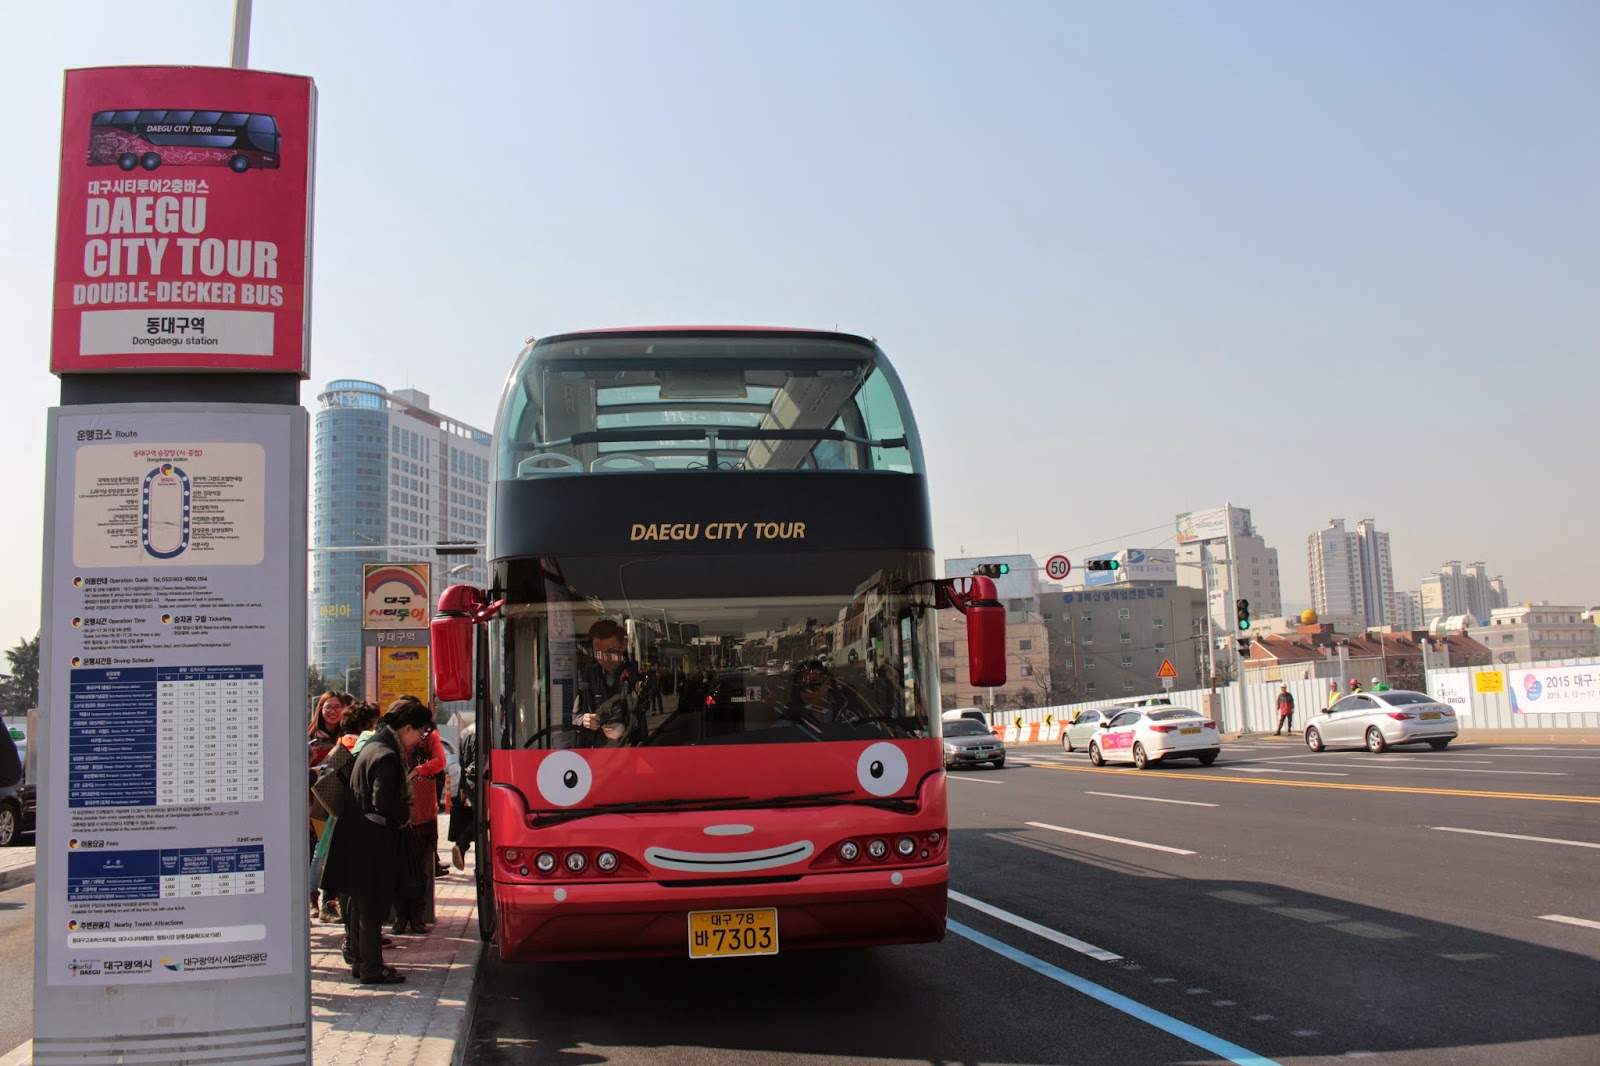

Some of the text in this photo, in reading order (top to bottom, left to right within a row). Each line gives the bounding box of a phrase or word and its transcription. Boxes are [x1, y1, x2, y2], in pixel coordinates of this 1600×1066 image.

[88, 180, 209, 194] 대구시티투어2층버스
[86, 196, 207, 235] DAEGU
[84, 238, 278, 278] CITY TOUR
[73, 282, 284, 306] DOUBLE-DECKER BUS
[146, 317, 205, 334] 동대구역
[132, 336, 218, 346] Dongdaegu station
[76, 430, 138, 442] 운행코스 Route
[133, 450, 157, 458] 동대구역
[630, 522, 806, 540] DAEGU CITY TOUR
[1051, 561, 1066, 574] 50
[85, 577, 108, 585] 이용안내
[384, 597, 411, 605] 대구
[320, 604, 351, 618] 마리아
[369, 608, 425, 622] 시티투어
[84, 618, 107, 626] 운행시간
[377, 632, 416, 642] 동대구역
[83, 658, 112, 666] 운행시간표
[1546, 674, 1600, 688] 2015 대구·
[80, 840, 104, 848] 이용요금
[80, 921, 110, 930] 주변관광지
[711, 913, 754, 926] 대구 78
[104, 960, 152, 970] 대구광역시
[184, 952, 268, 966] 대구광역시 시설관리공단
